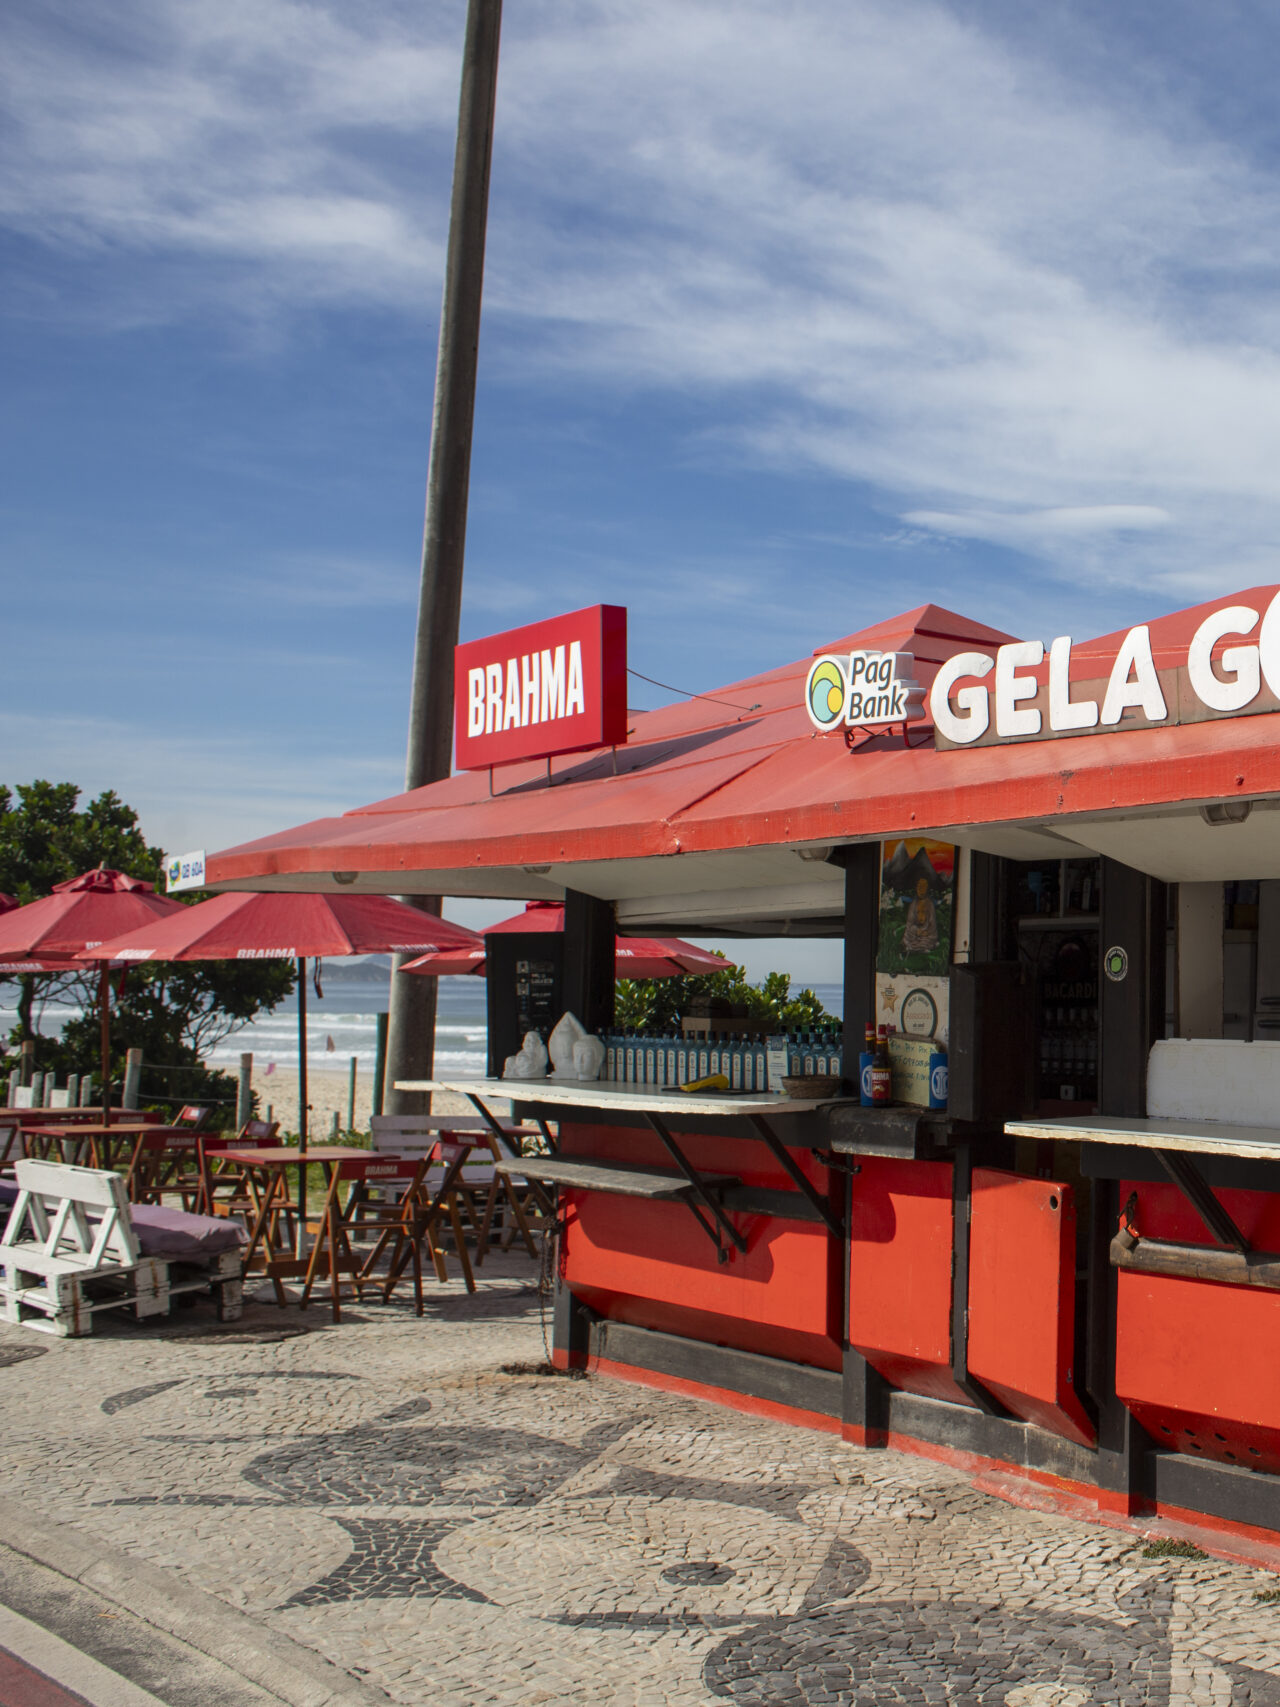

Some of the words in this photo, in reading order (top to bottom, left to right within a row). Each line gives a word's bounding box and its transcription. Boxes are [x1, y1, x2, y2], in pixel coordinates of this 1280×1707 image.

[468, 640, 585, 738] BRAHMA
[851, 656, 893, 691] Pag
[930, 625, 1168, 744] GELA
[849, 685, 904, 720] Bank
[237, 948, 296, 959] BRAHMA
[364, 1165, 398, 1177] BRAHMA
